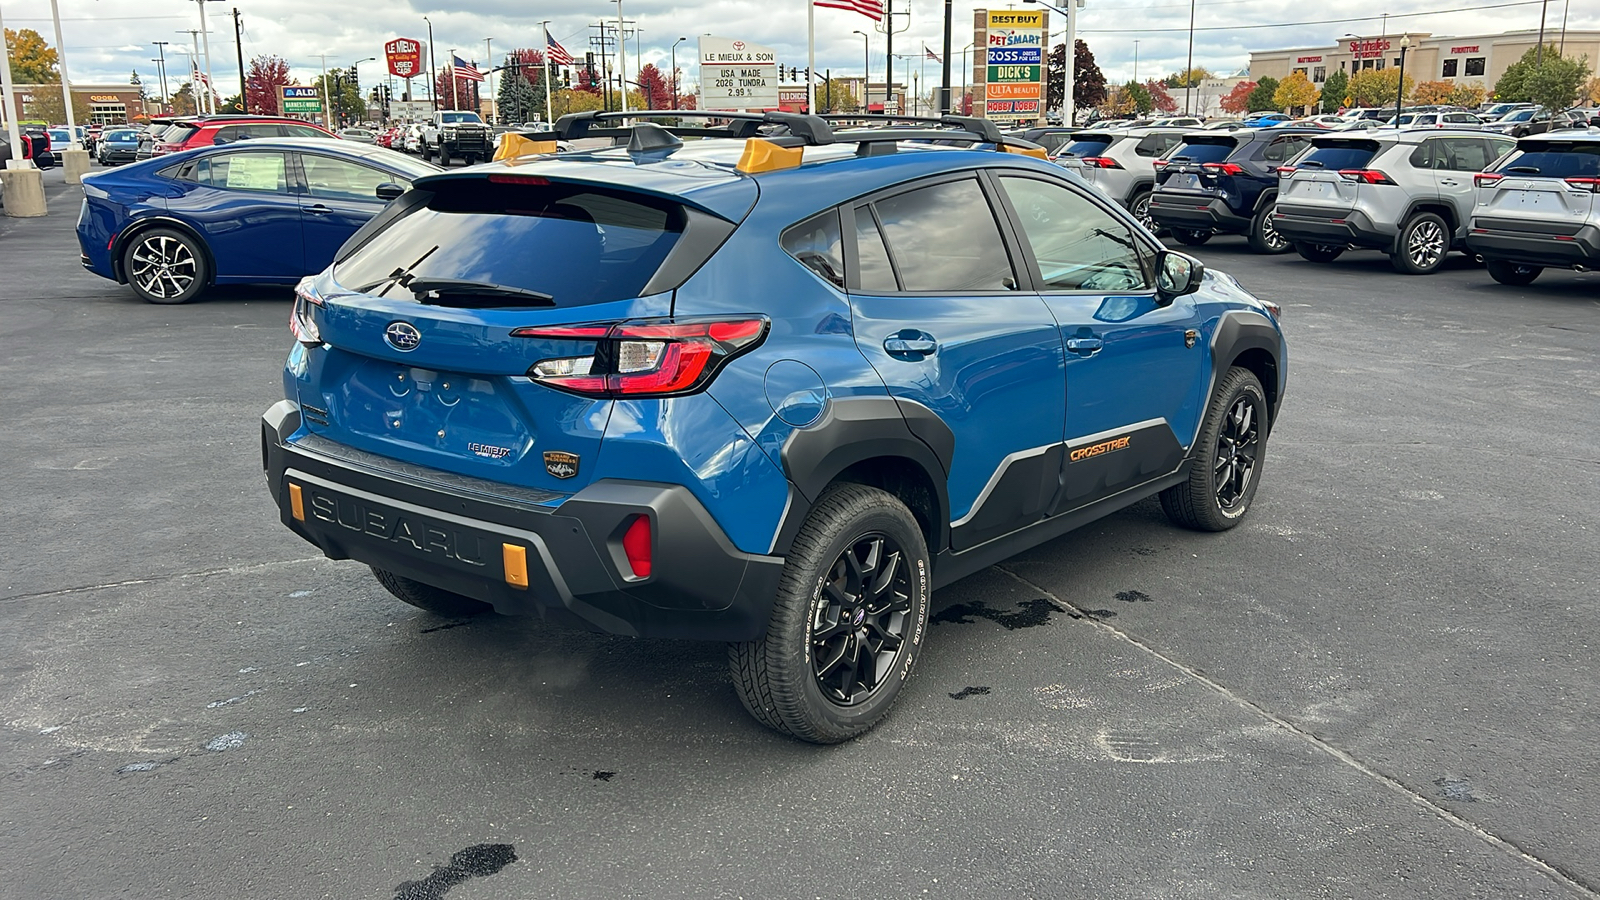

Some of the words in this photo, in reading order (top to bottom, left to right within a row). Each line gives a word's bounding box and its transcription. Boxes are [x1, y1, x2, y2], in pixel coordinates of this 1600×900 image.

[991, 15, 1016, 24] BEST
[1017, 15, 1039, 24] BUY
[387, 43, 395, 53] LE
[397, 41, 417, 53] MIEUX
[1349, 38, 1390, 52] Stenhafels
[1451, 45, 1480, 54] FURNITURE
[704, 53, 715, 61] LE
[718, 53, 744, 61] MIEUX
[746, 53, 753, 61] &
[755, 53, 774, 61] SON
[988, 51, 1019, 61] ROSS
[1354, 51, 1383, 59] SPERSTORE
[396, 67, 411, 75] CARS
[720, 69, 736, 78] USA
[740, 69, 761, 77] MADE
[997, 66, 1031, 79] DICK'S
[715, 79, 734, 87] 2026
[738, 79, 766, 87] TUNDRA
[295, 88, 318, 97] ALDI
[727, 88, 745, 97] 2.99
[990, 86, 1012, 94] ULTA
[780, 92, 790, 100] OLD
[987, 101, 1012, 112] HOBBY
[1013, 101, 1039, 112] LOBBY
[467, 442, 480, 451] LE
[480, 444, 511, 457] MIEUX
[1069, 435, 1131, 462] CROSSTREK
[310, 490, 488, 567] SUBARU
